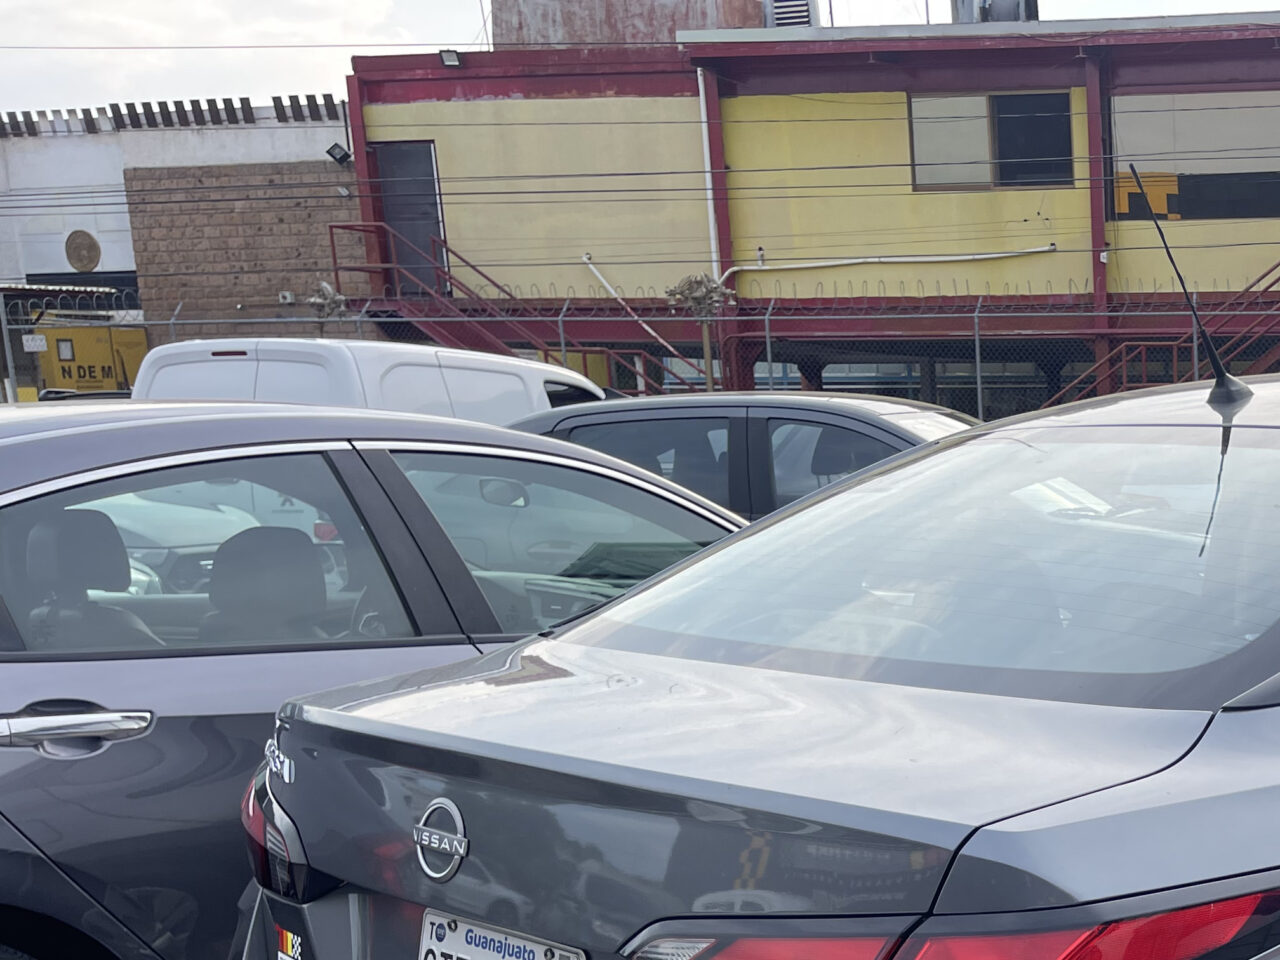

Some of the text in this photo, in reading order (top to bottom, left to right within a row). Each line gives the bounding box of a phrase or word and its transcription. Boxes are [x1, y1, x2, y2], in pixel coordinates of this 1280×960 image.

[61, 365, 113, 379] N DE M
[413, 828, 466, 854] NISSAN
